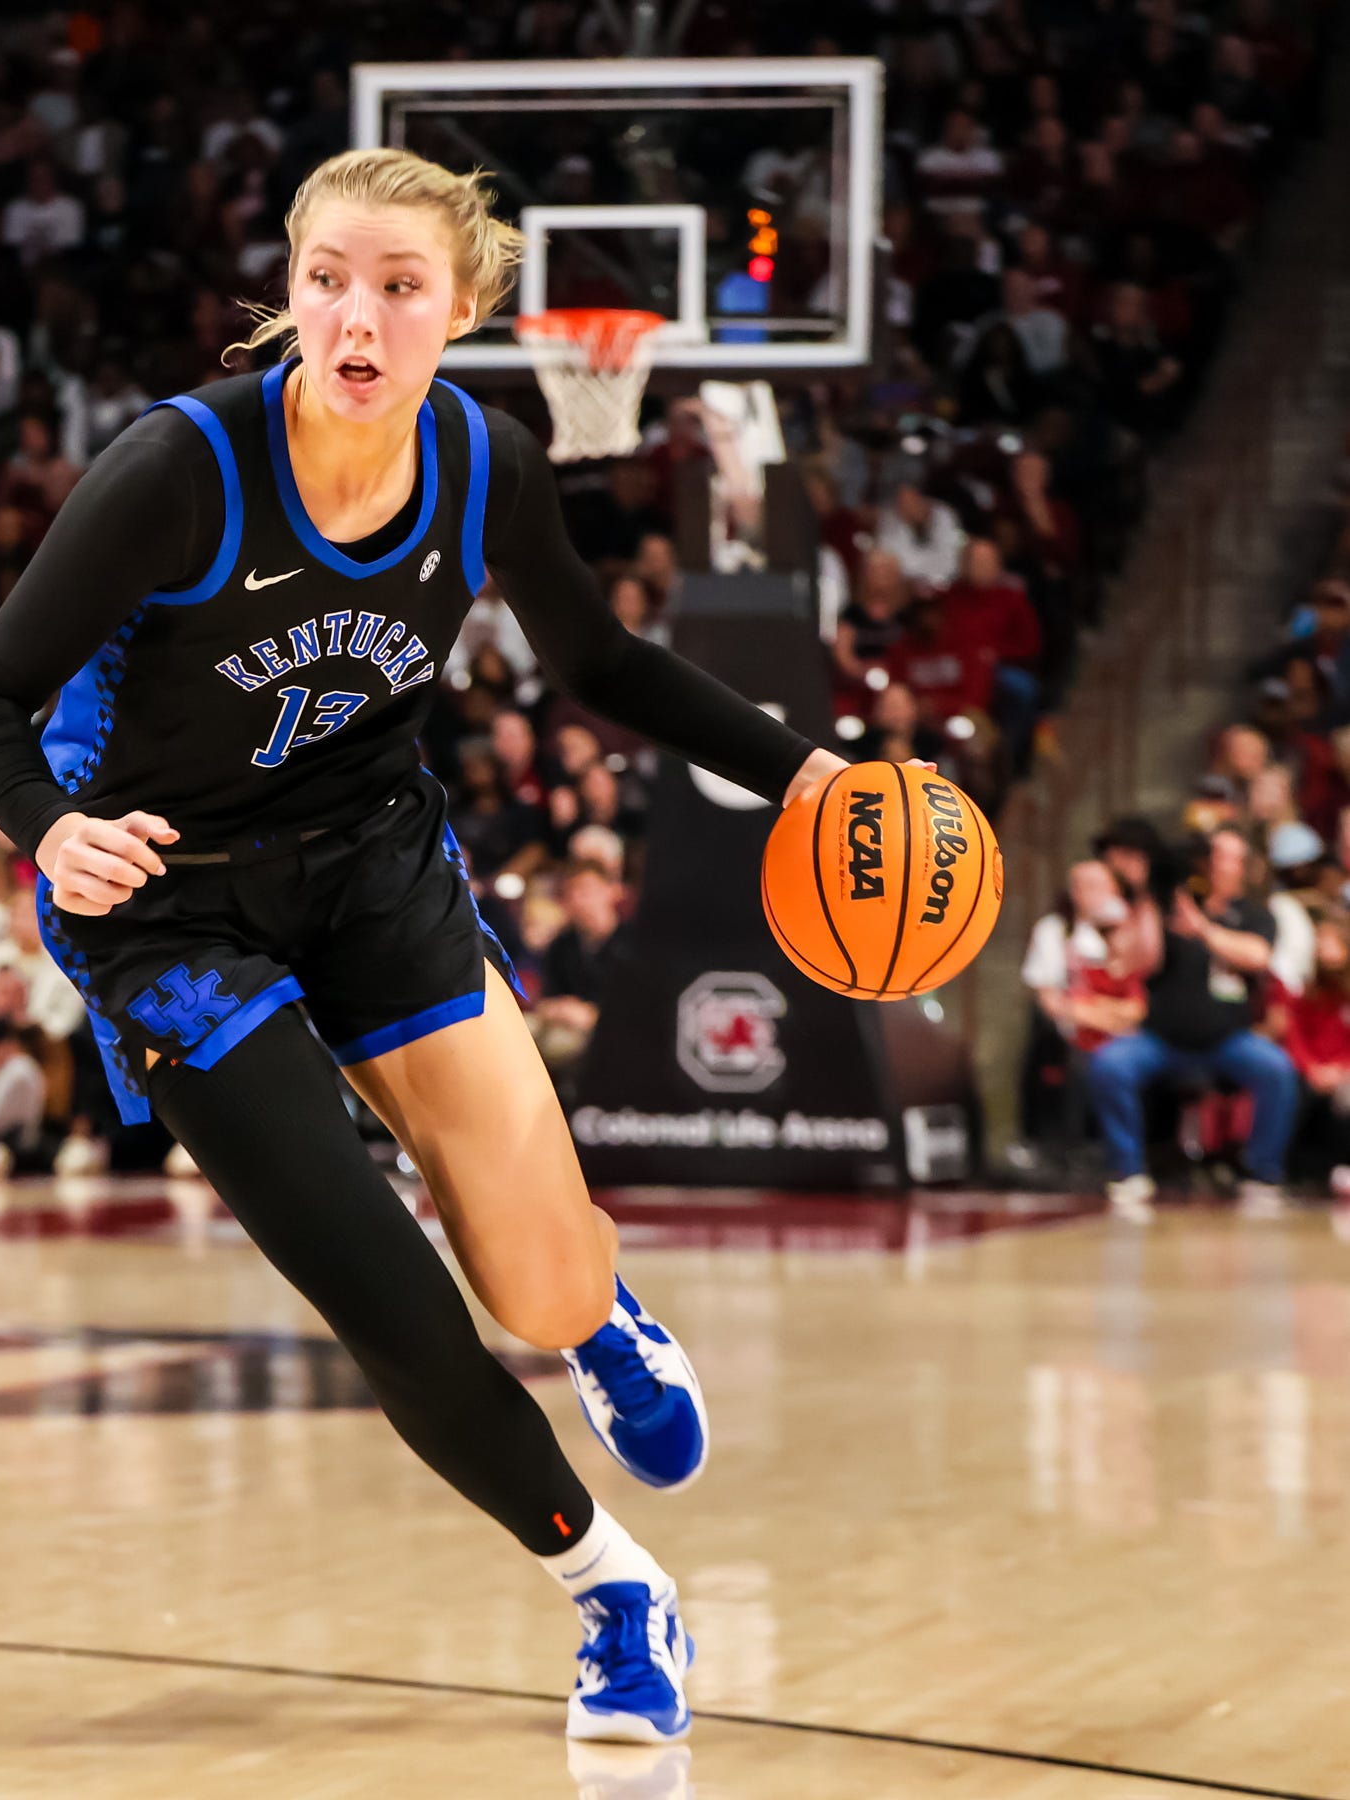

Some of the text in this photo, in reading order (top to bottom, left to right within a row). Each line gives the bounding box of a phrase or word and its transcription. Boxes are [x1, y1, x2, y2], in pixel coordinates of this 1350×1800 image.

[214, 609, 435, 696] KENTUCKY
[250, 685, 370, 768] 13
[848, 790, 885, 900] NCAA
[919, 781, 968, 925] Wilson
